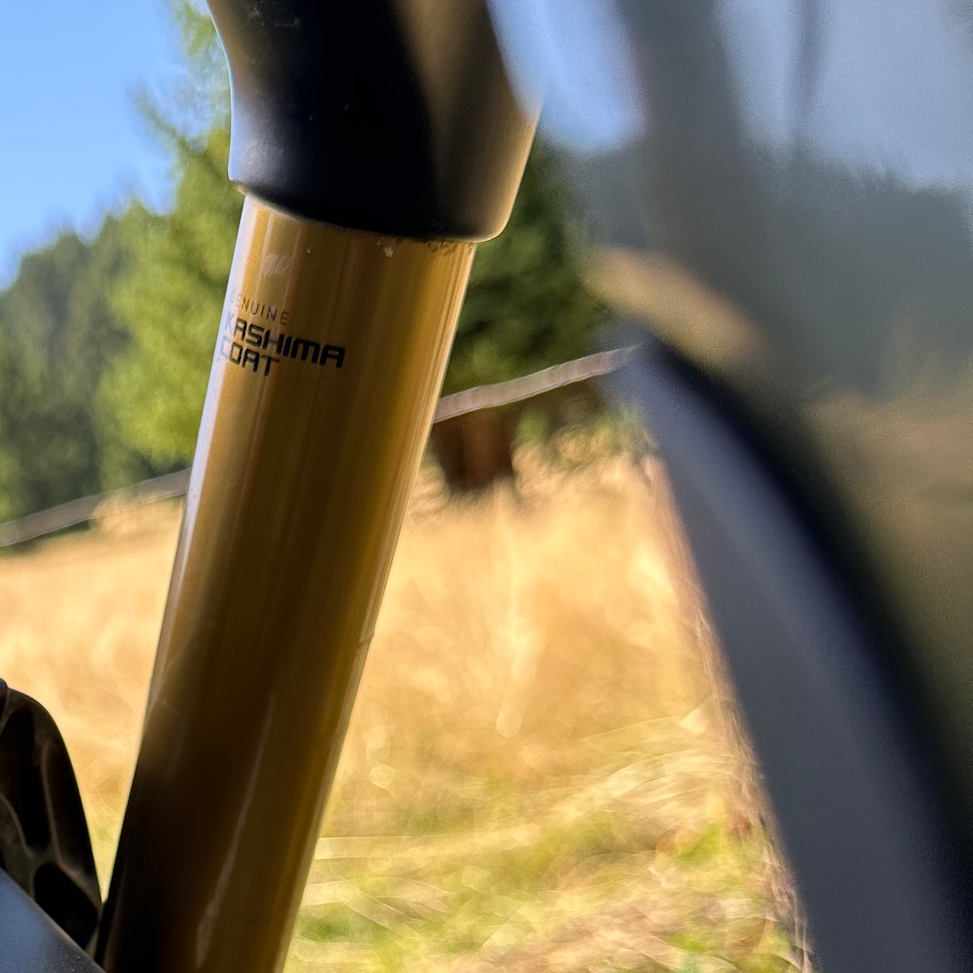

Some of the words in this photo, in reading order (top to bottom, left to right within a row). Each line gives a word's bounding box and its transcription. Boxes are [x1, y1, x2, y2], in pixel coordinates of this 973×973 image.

[230, 290, 291, 326] GENUINE
[220, 337, 281, 377] COAT
[223, 311, 346, 369] KASHIMA
